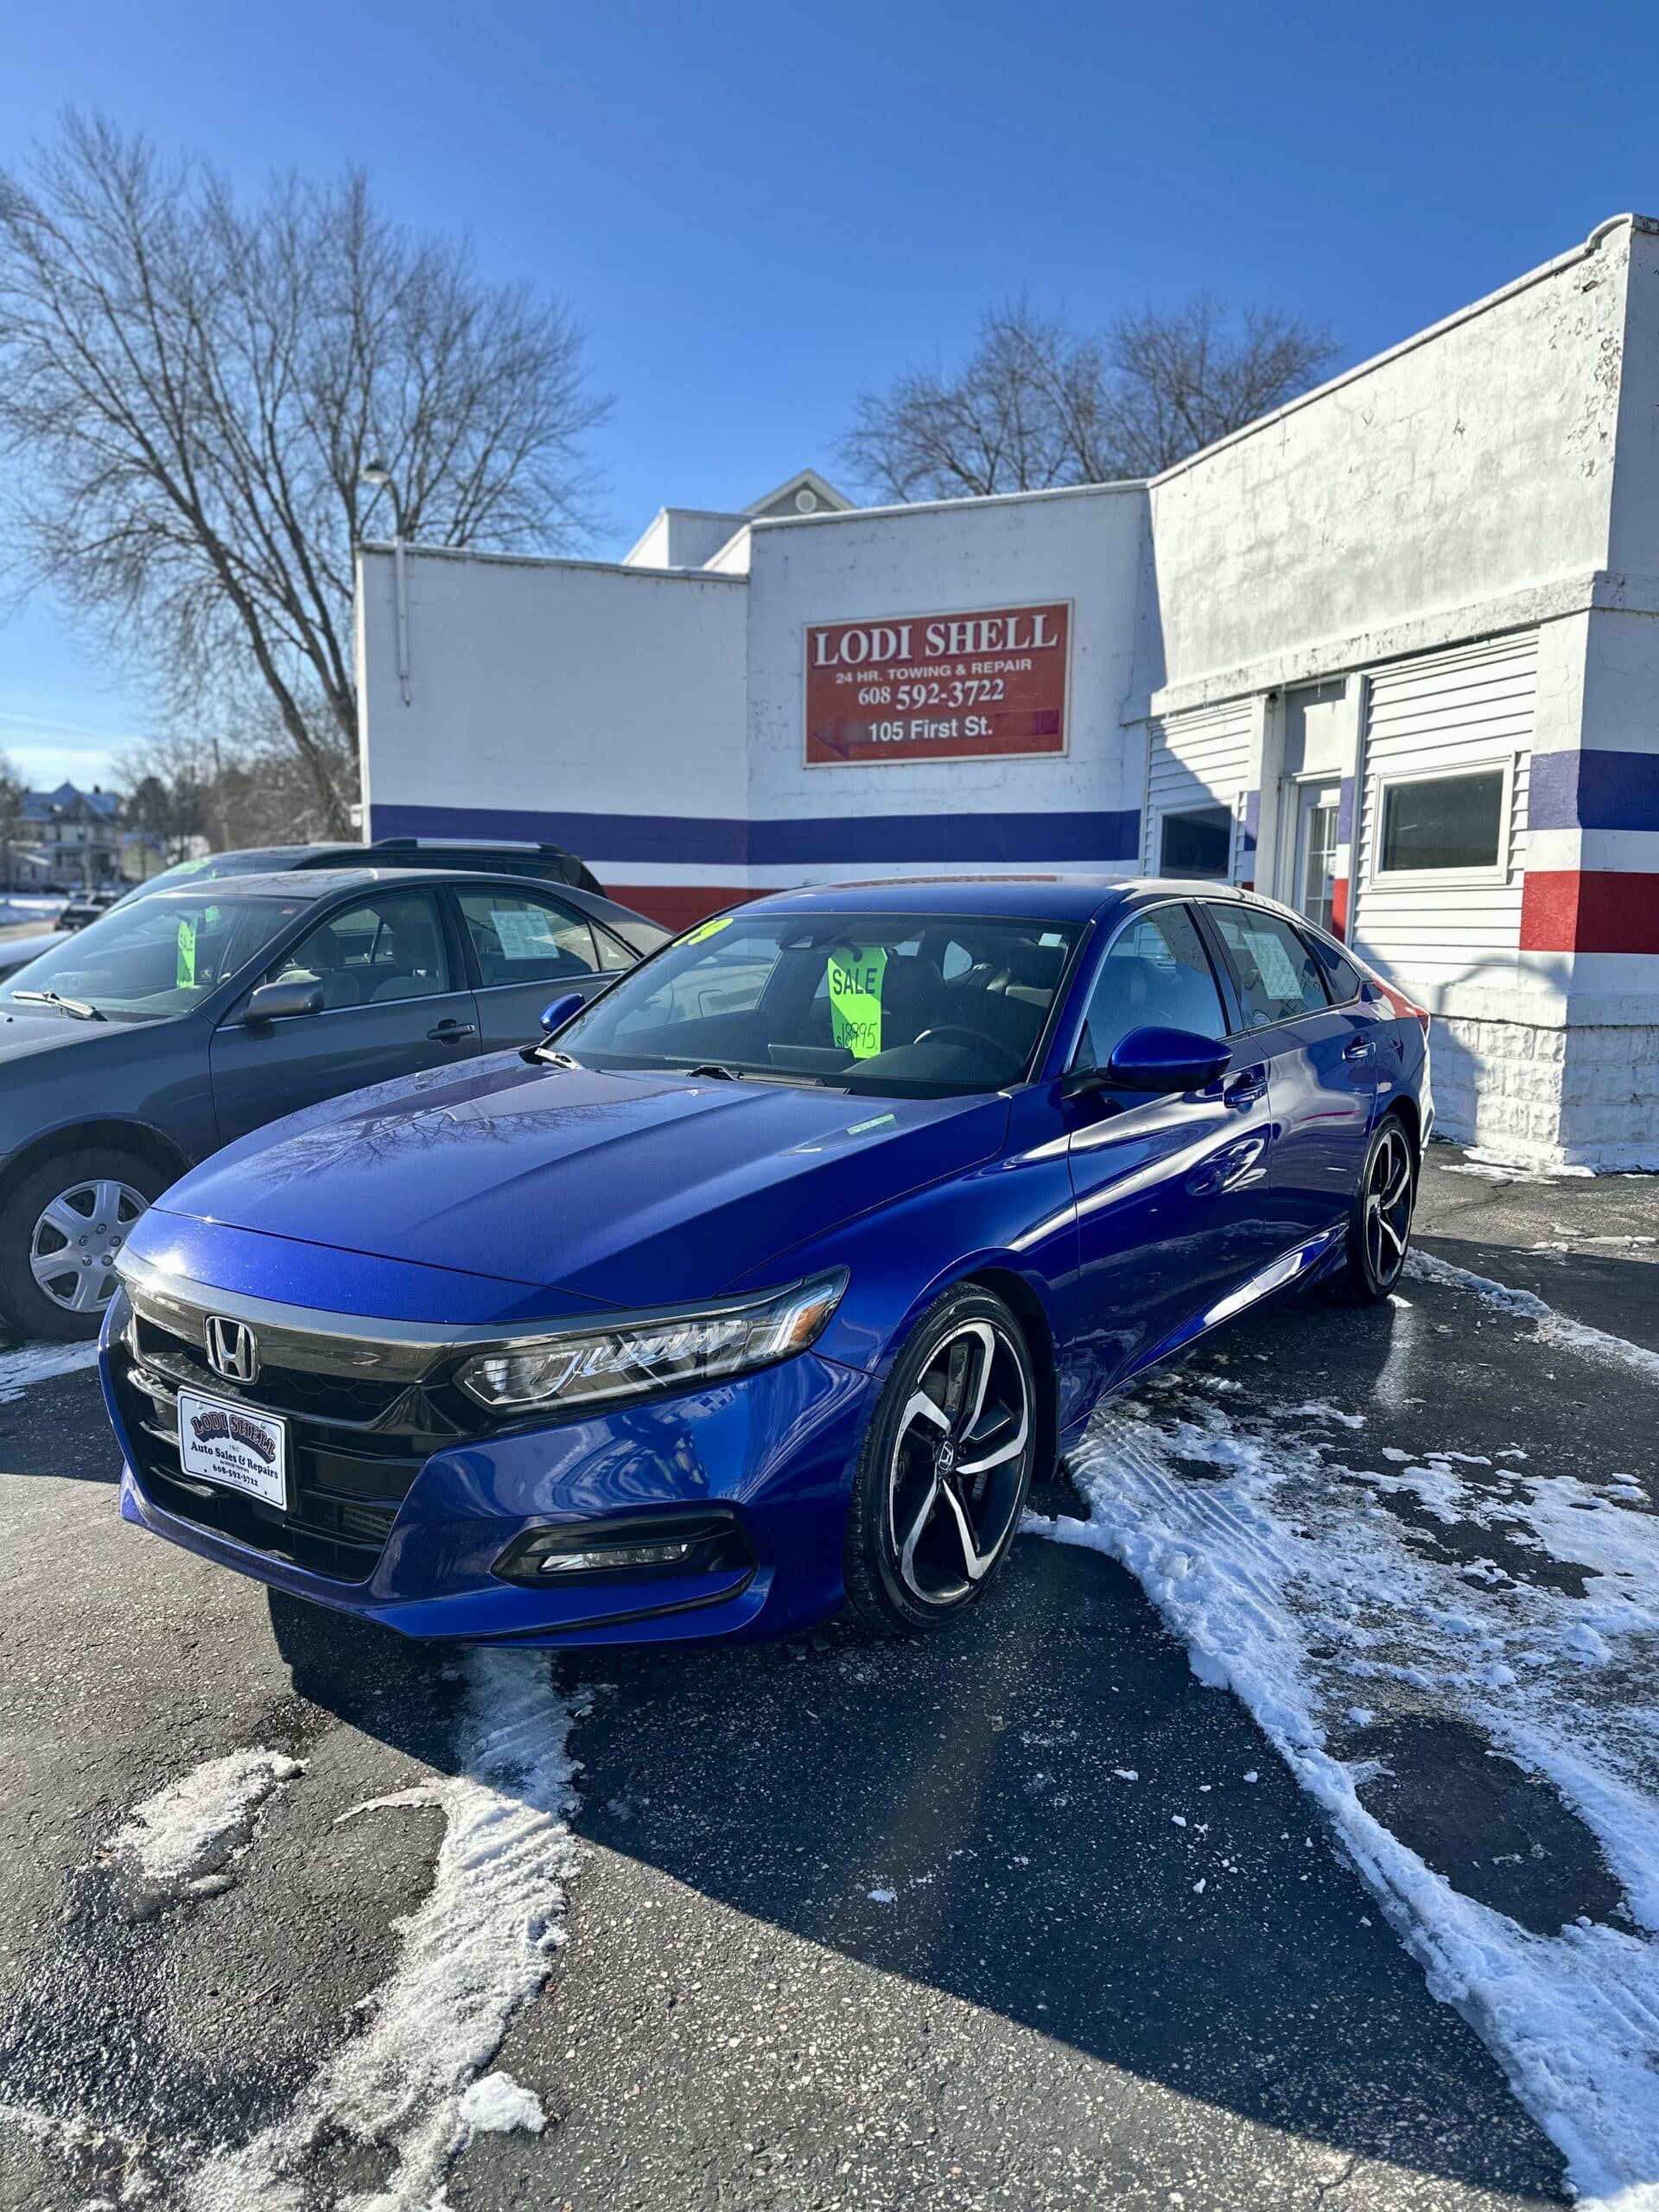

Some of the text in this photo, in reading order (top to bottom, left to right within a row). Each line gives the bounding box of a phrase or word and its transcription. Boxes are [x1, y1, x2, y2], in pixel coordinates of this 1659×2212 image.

[814, 614, 1058, 666] LODI SHELL
[836, 658, 1033, 684] 24 HR. TOWING & REPAIR
[858, 678, 1005, 711] 608 592-3722
[868, 715, 993, 742] 105 First St.
[832, 967, 878, 995] SALE
[190, 1411, 276, 1461] LODI SHELL
[191, 1440, 213, 1455] Auto
[214, 1447, 238, 1464] Sales
[238, 1455, 245, 1466] &
[247, 1458, 278, 1479] Repairs
[213, 1464, 259, 1486] 608-592-3722
